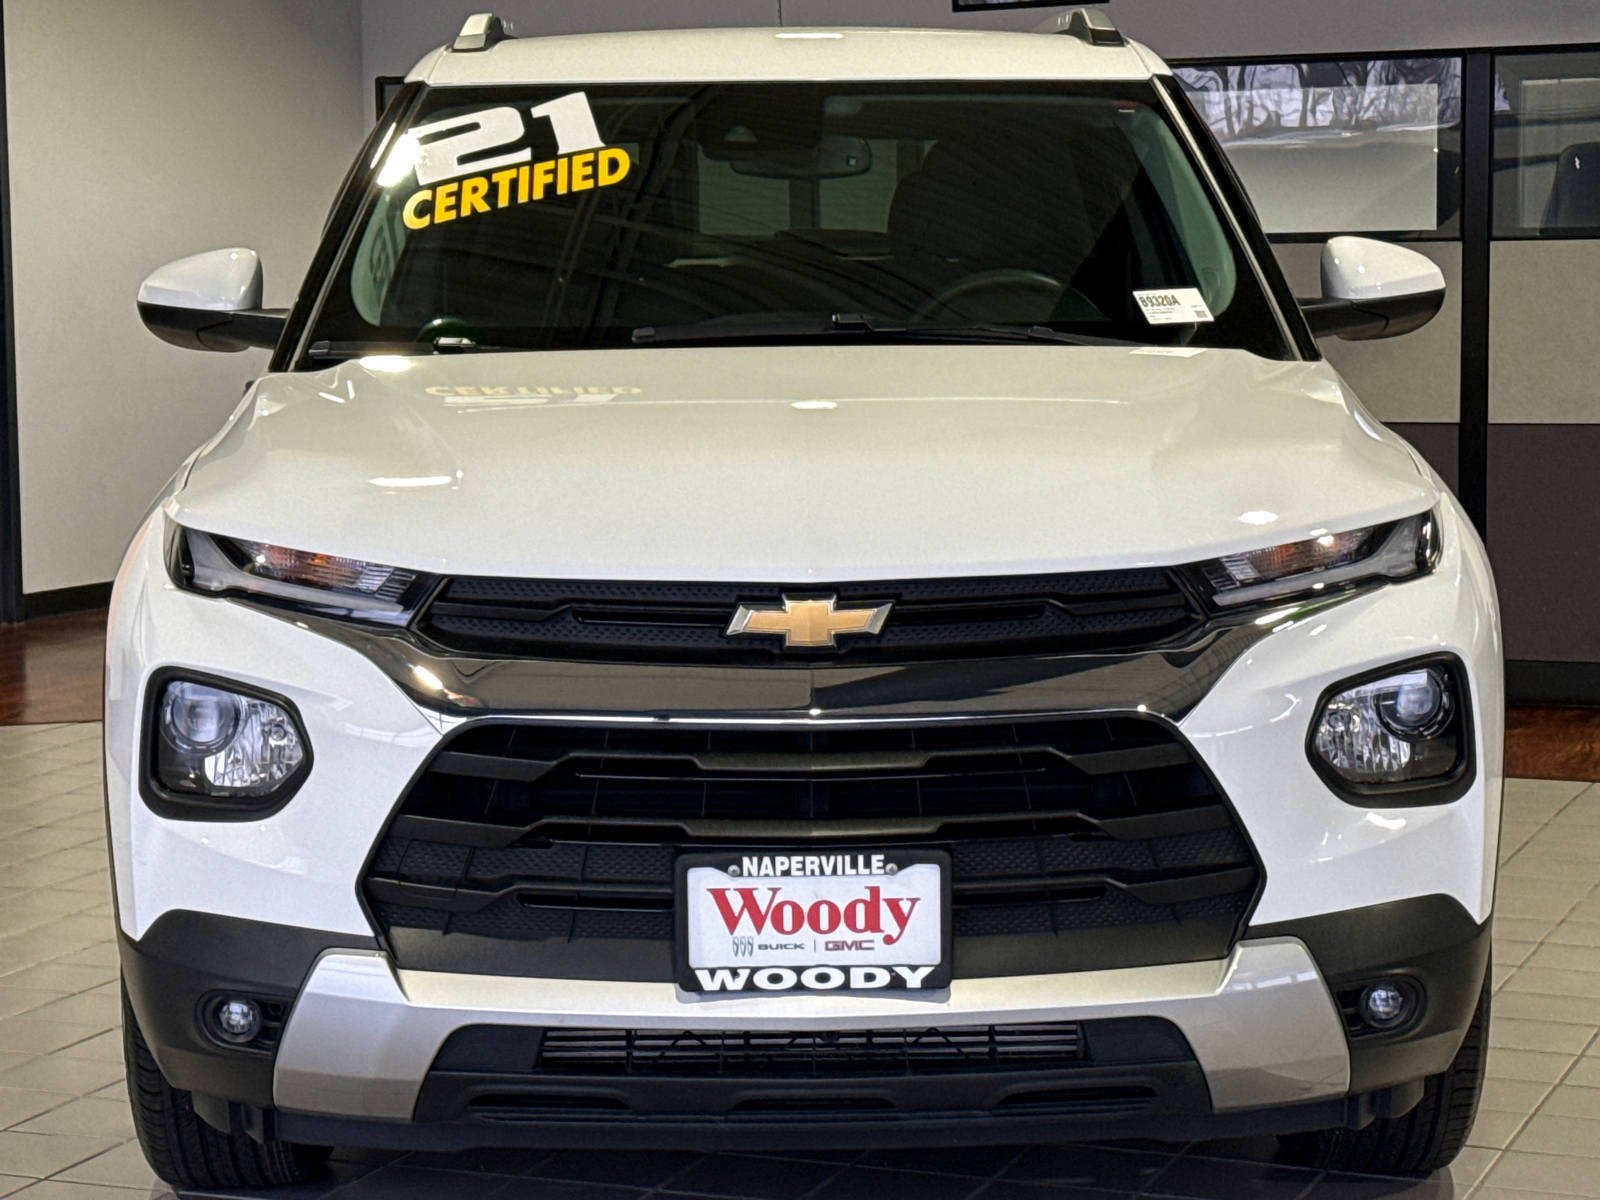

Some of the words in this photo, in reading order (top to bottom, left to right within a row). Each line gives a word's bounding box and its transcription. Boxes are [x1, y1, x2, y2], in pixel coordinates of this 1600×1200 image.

[408, 91, 606, 186] 21
[402, 148, 630, 229] CERTIFIED
[742, 854, 885, 876] NAPERVILLE
[706, 886, 921, 946] Woody
[757, 942, 805, 951] BUICK
[824, 939, 875, 951] GMC
[694, 966, 935, 991] WOODY
